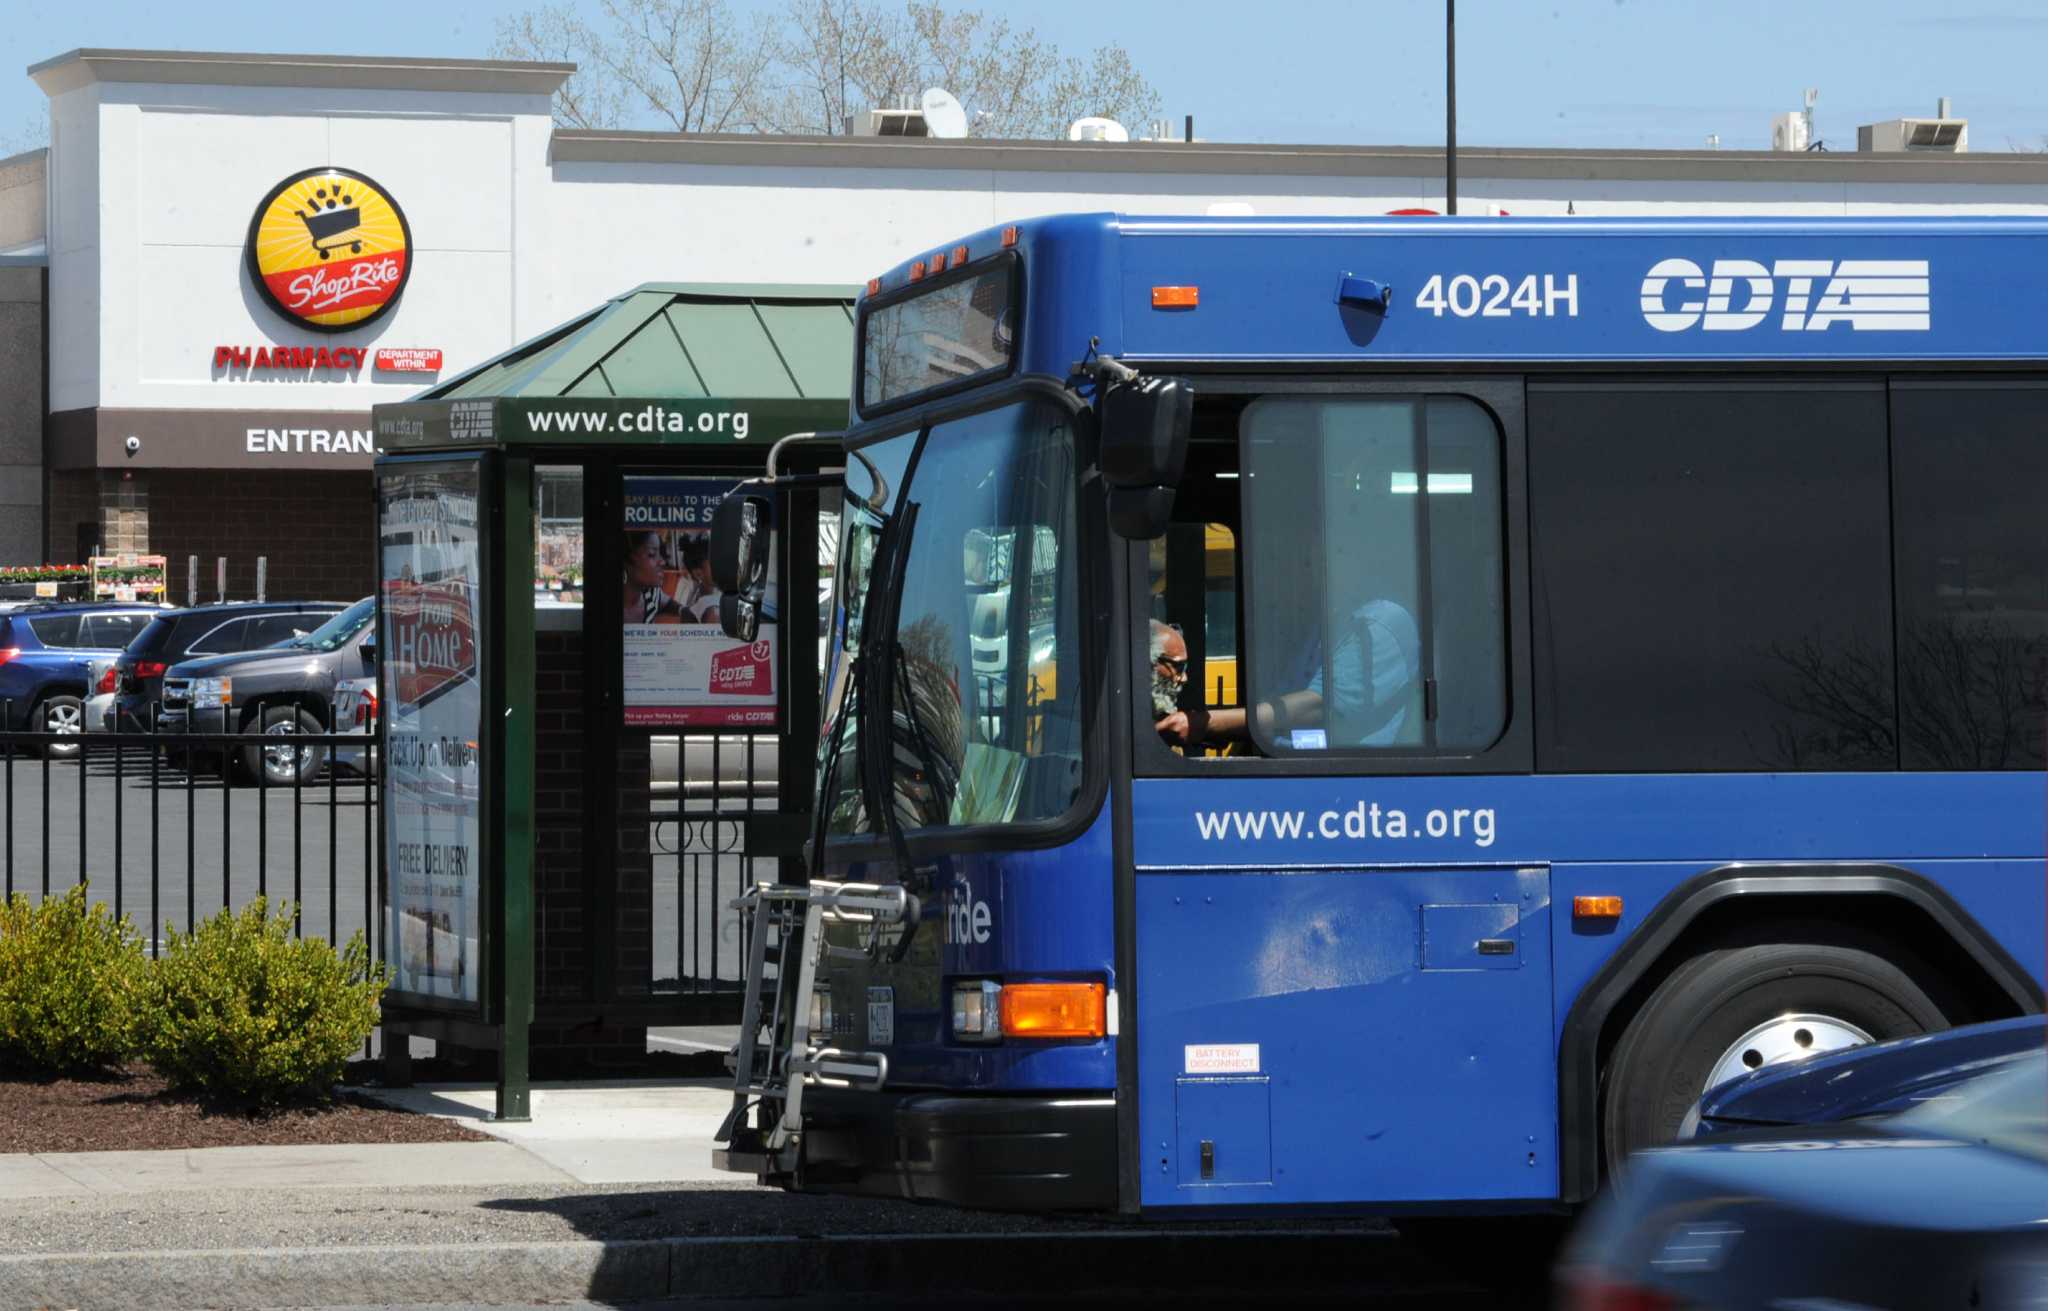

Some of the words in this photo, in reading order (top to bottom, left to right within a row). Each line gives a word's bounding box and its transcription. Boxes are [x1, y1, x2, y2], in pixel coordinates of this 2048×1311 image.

[288, 257, 399, 309] ShopRite
[1416, 274, 1578, 317] 4024H
[1640, 258, 1930, 333] CDTA
[216, 346, 368, 369] PHARMACY
[378, 350, 438, 360] DEPARTMENT
[393, 359, 426, 369] WITHIN
[527, 405, 749, 440] www.cdta.org
[246, 428, 384, 453] ENTRAN
[685, 496, 697, 505] TO
[702, 496, 721, 505] THE
[625, 507, 695, 522] ROLLING
[728, 711, 743, 721] ride
[745, 711, 775, 721] CDTA
[1195, 801, 1495, 846] www.cdta.org
[398, 844, 421, 874] FREE
[425, 844, 469, 876] DELIVERY
[946, 880, 992, 945] ride
[1190, 1058, 1255, 1069] DISCONNECT
[1195, 1048, 1240, 1058] BATTERY
